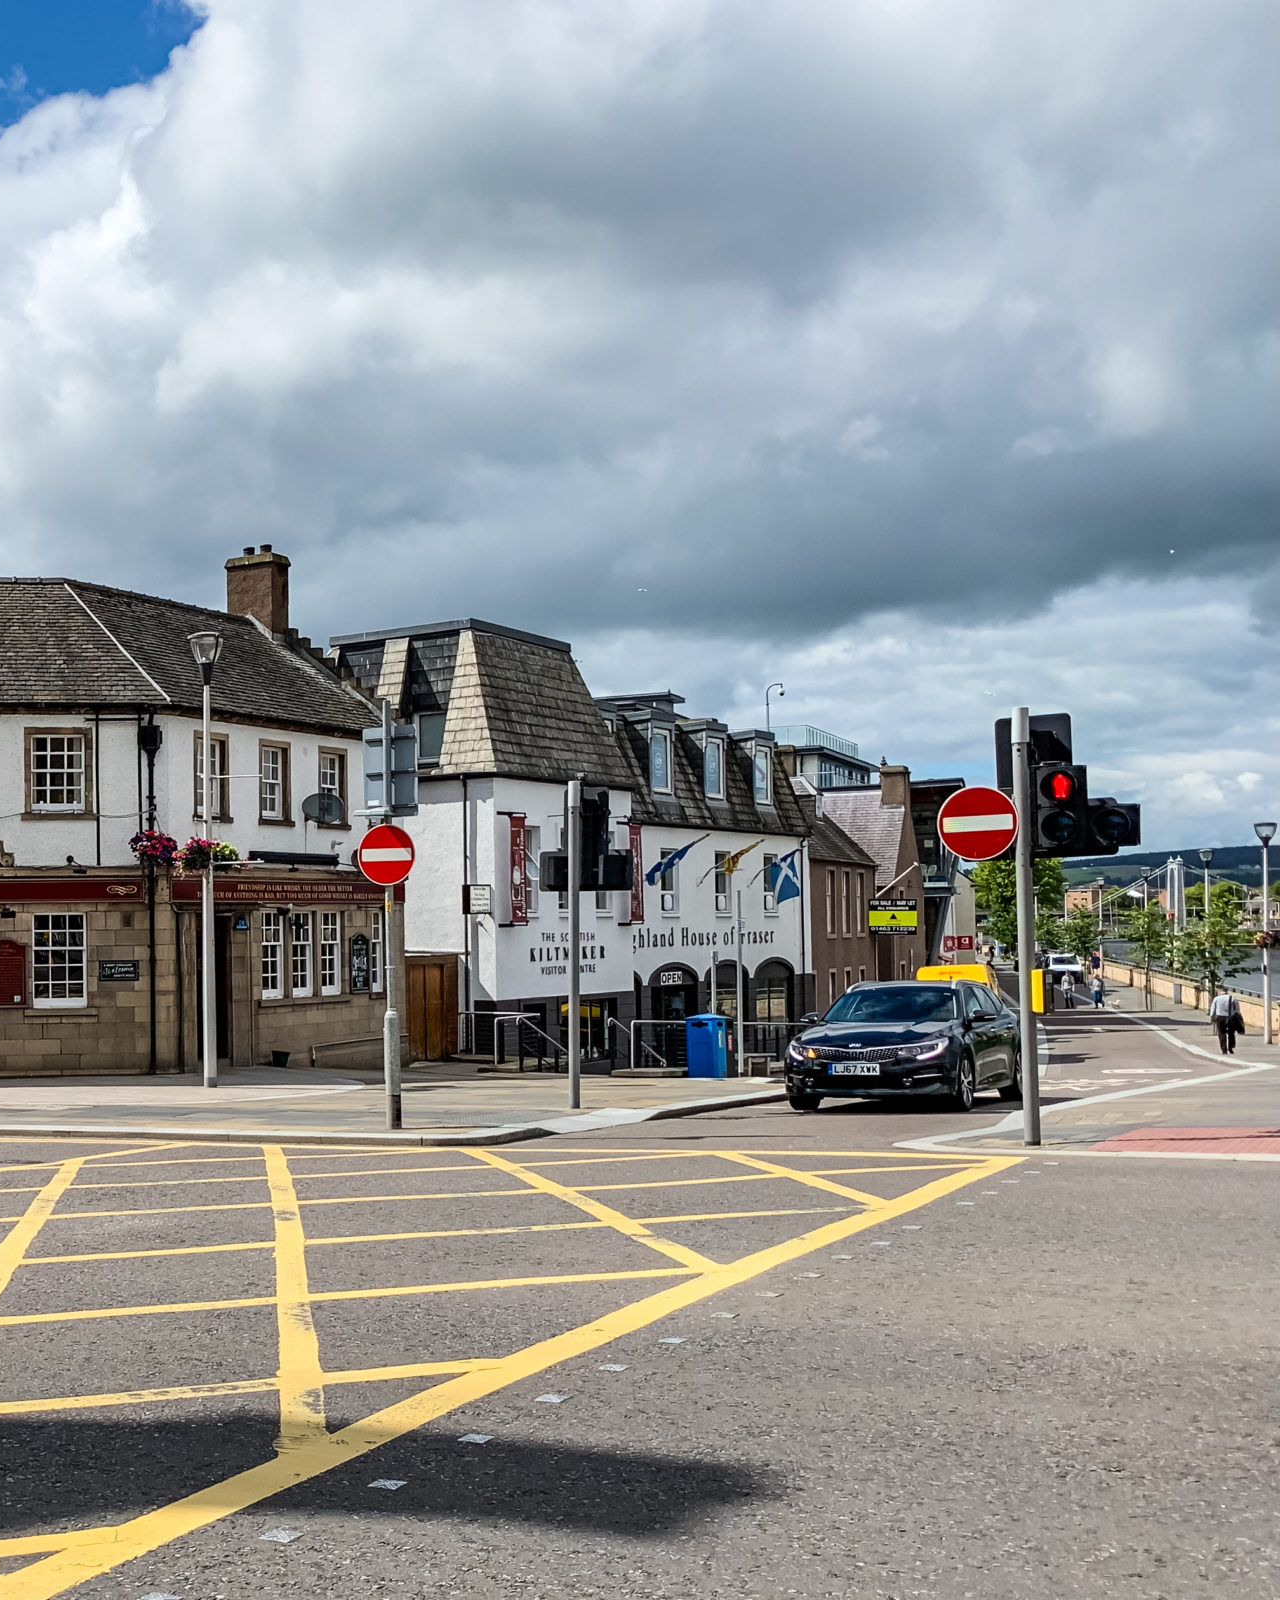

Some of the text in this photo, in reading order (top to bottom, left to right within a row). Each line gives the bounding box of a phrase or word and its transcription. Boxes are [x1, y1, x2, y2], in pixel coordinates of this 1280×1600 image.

[542, 932, 596, 942] THE SCTISH
[681, 927, 717, 946] House
[724, 926, 735, 945] of
[530, 946, 605, 962] KILTMKER
[541, 964, 596, 975] VISITOR NTRE
[661, 972, 682, 984] OPEN
[834, 1065, 878, 1073] LJ67 XWK
